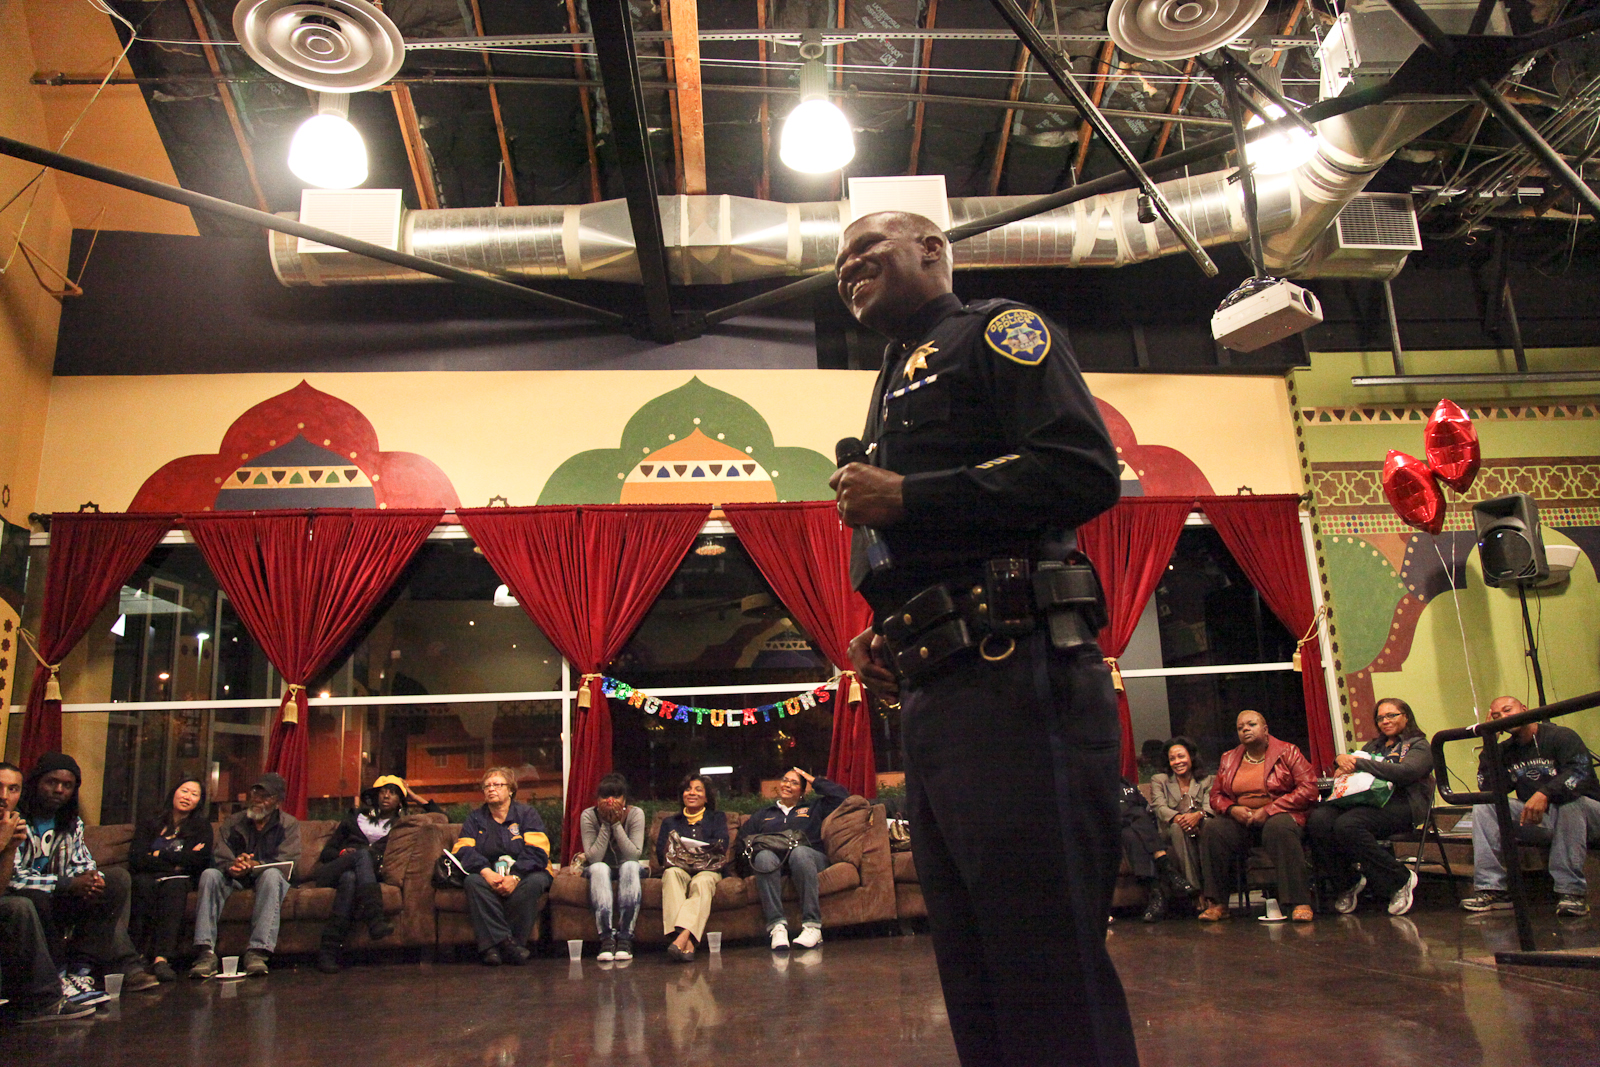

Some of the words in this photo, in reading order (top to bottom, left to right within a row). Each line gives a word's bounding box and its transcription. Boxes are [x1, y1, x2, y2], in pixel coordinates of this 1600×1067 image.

[990, 311, 1035, 333] OAKLAND
[997, 317, 1032, 333] POLICE
[601, 676, 831, 727] CONGRATULATIONS
